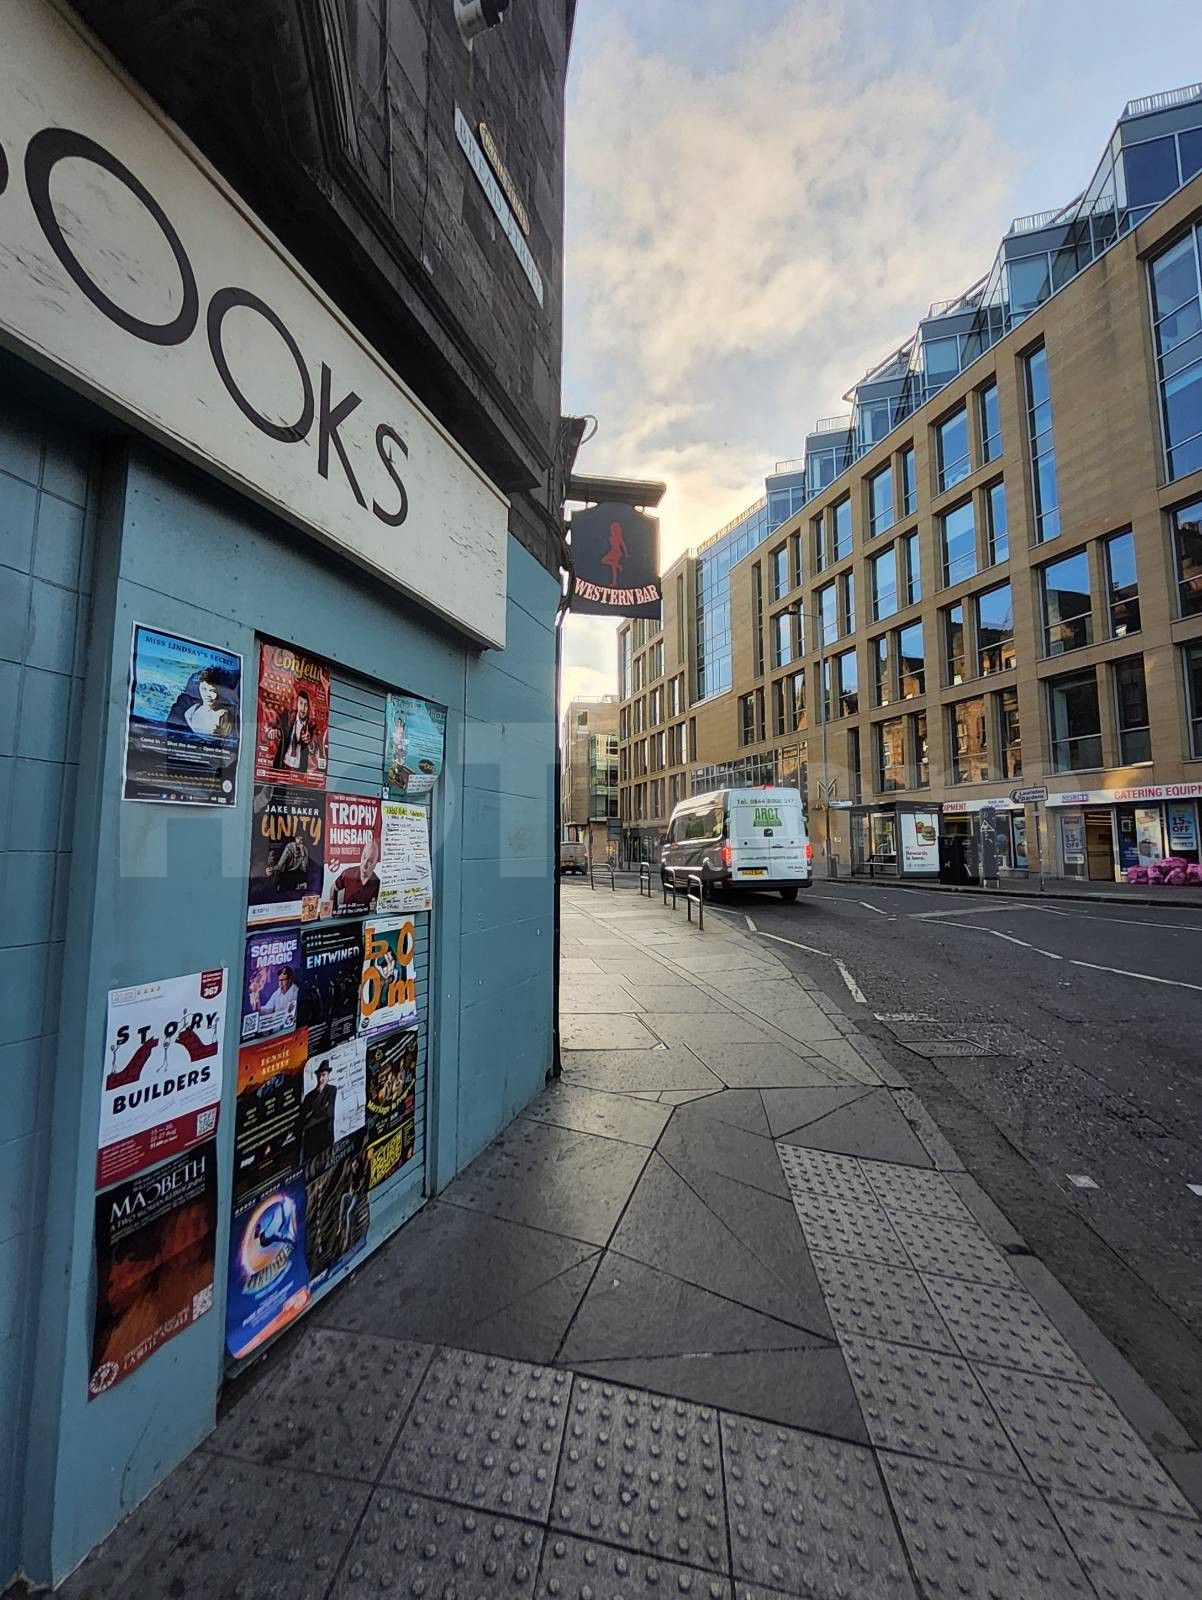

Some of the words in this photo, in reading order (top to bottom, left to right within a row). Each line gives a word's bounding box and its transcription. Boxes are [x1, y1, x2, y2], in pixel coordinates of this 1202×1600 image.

[0, 128, 409, 527] OOKS
[574, 577, 635, 606] WESTERN
[636, 584, 660, 605] BAR
[1114, 787, 1163, 801] CATERING
[264, 804, 288, 814] JAKE
[291, 806, 320, 816] BAKER
[329, 802, 378, 827] TROPHY
[261, 814, 322, 846] UNITY
[1172, 825, 1191, 833] OFF
[250, 939, 298, 958] SCIENCE
[256, 951, 293, 969] MAGIC
[306, 945, 360, 970] ENTWINED
[116, 1011, 218, 1046] STORY
[112, 1065, 211, 1116] BUILDERS
